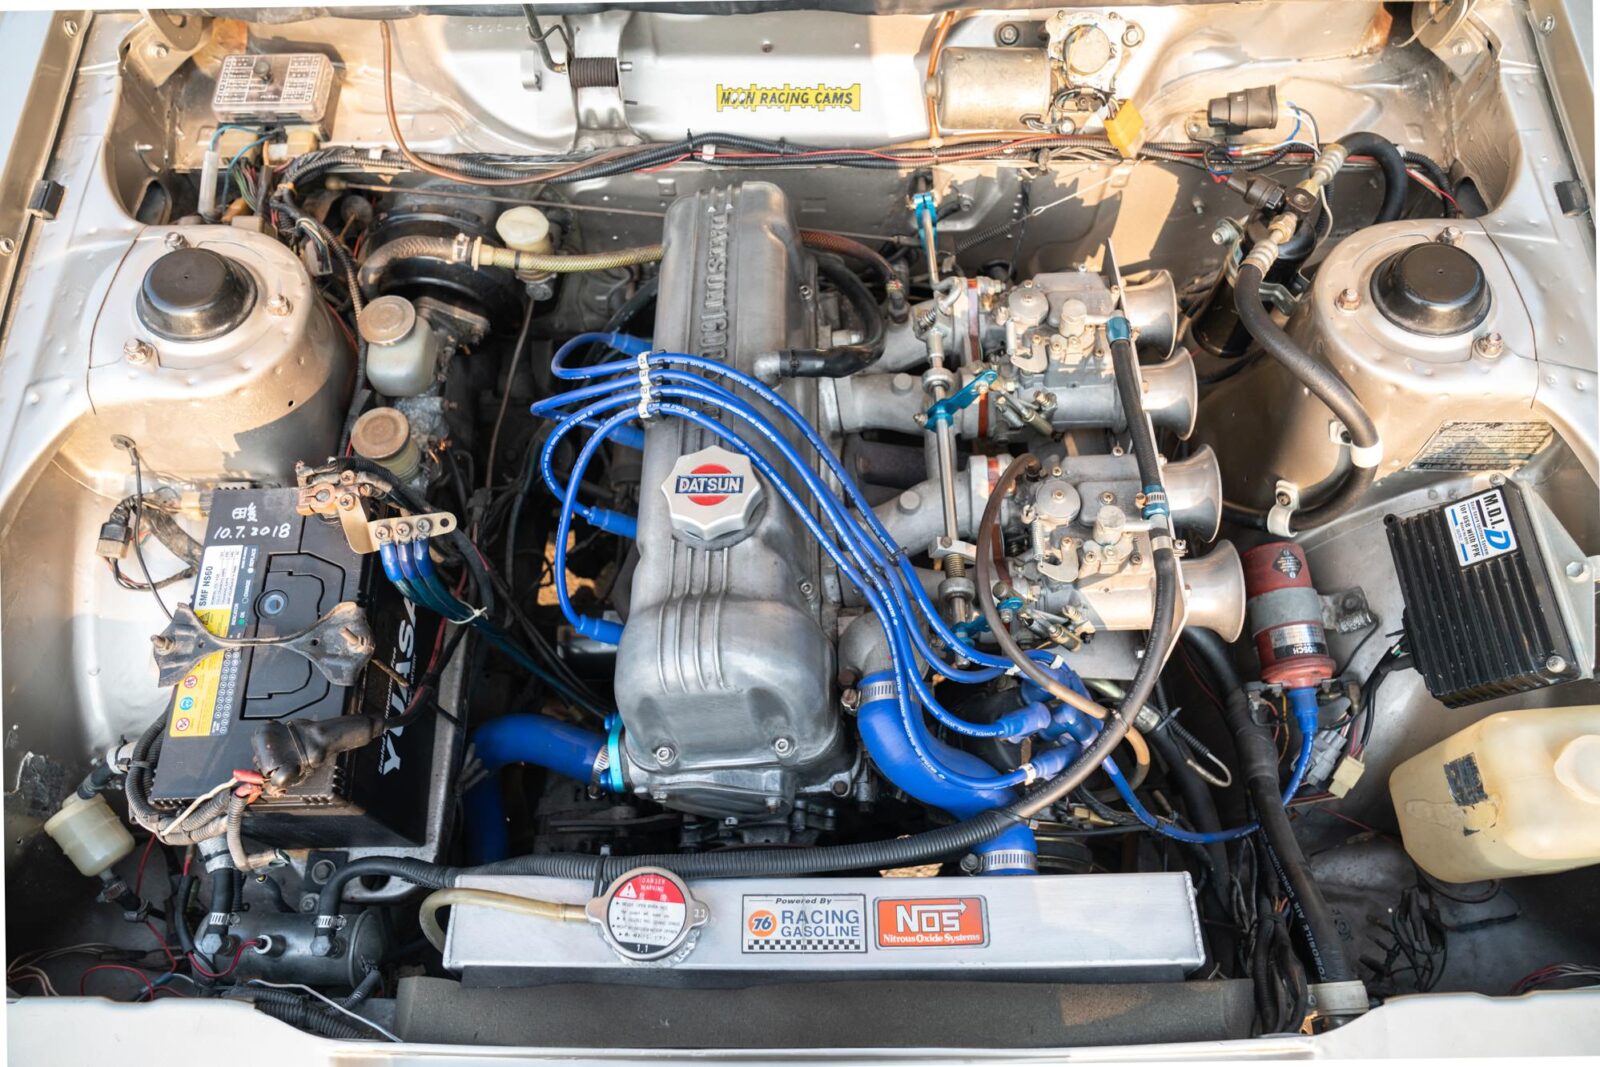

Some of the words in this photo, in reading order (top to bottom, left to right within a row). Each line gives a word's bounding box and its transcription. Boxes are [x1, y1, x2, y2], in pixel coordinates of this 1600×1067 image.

[720, 91, 755, 105] MOON
[760, 91, 809, 104] RACING
[815, 91, 853, 105] CAMS
[678, 477, 741, 492] DATSUN
[1459, 504, 1467, 514] for
[1483, 493, 1504, 529] M.D.I.
[1462, 515, 1471, 528] use
[213, 522, 291, 539] 10.7.2018
[1467, 529, 1475, 543] with
[198, 588, 209, 607] SMF
[383, 597, 416, 775] YUASA
[775, 897, 817, 905] Powered
[819, 897, 832, 905] By
[752, 915, 772, 930] 76
[781, 909, 860, 925] RACING
[896, 903, 962, 933] NOS
[781, 925, 860, 937] GASOLINE
[883, 933, 916, 943] Nitrous
[916, 933, 943, 944] Oxide
[943, 933, 981, 944] Systems
[636, 944, 649, 954] 1.1
